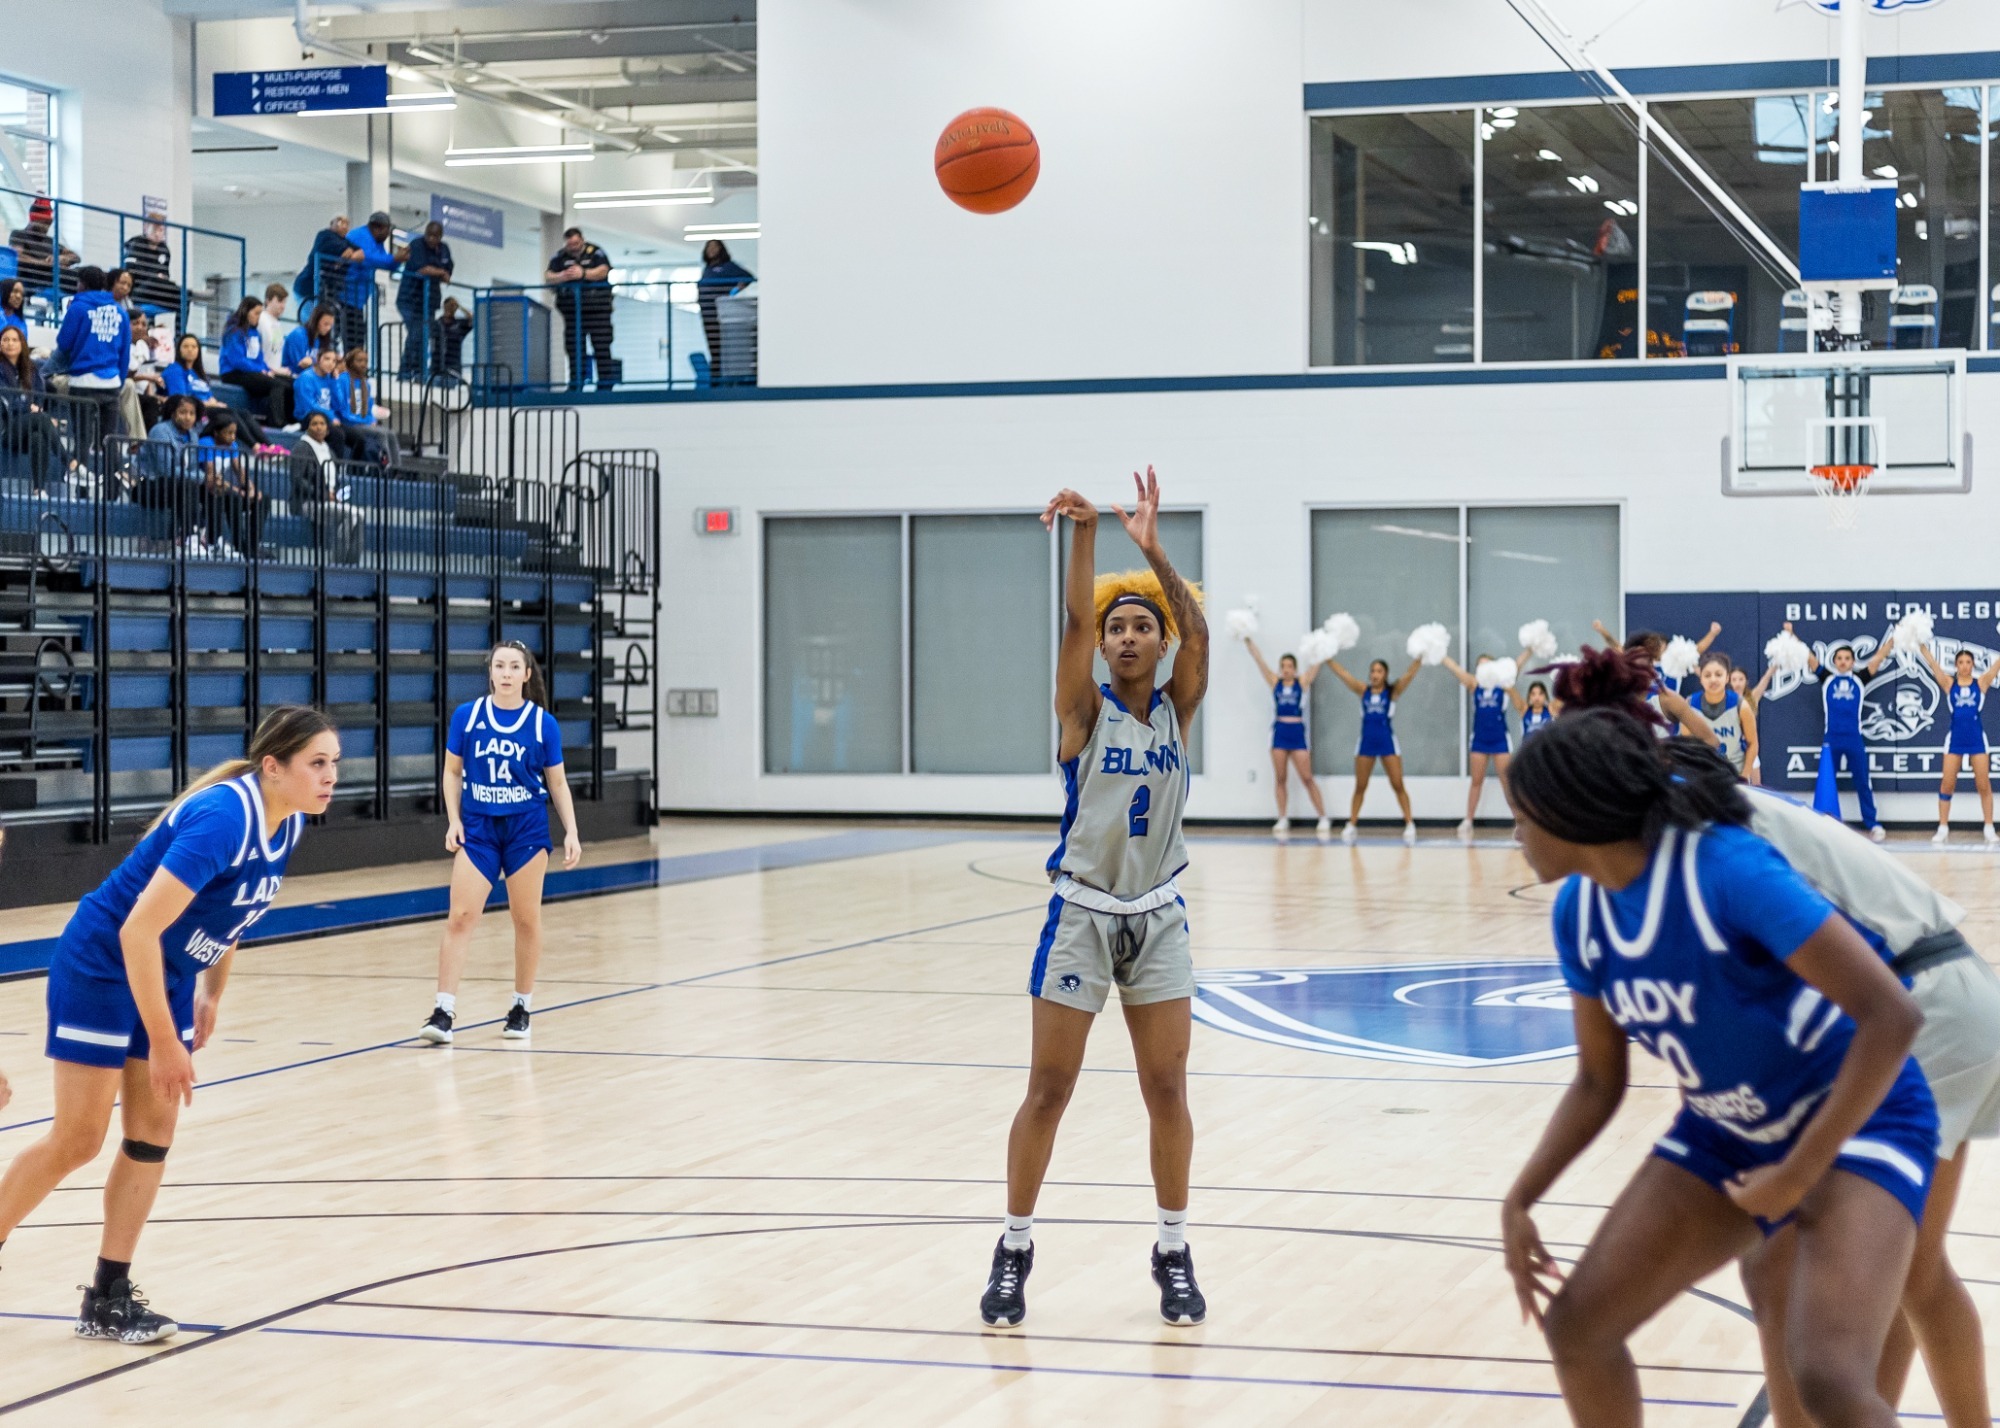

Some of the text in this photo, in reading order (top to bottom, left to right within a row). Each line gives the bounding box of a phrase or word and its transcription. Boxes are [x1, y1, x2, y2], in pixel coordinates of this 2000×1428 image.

[264, 69, 342, 84] MULTI-PURPOSE
[264, 85, 320, 98] RESTROOM
[326, 83, 350, 95] MEN
[264, 100, 307, 112] OFFICES
[1786, 603, 1867, 620] BLINN
[475, 738, 526, 762] LADY
[488, 757, 512, 783] 14
[1129, 784, 1151, 838] 2
